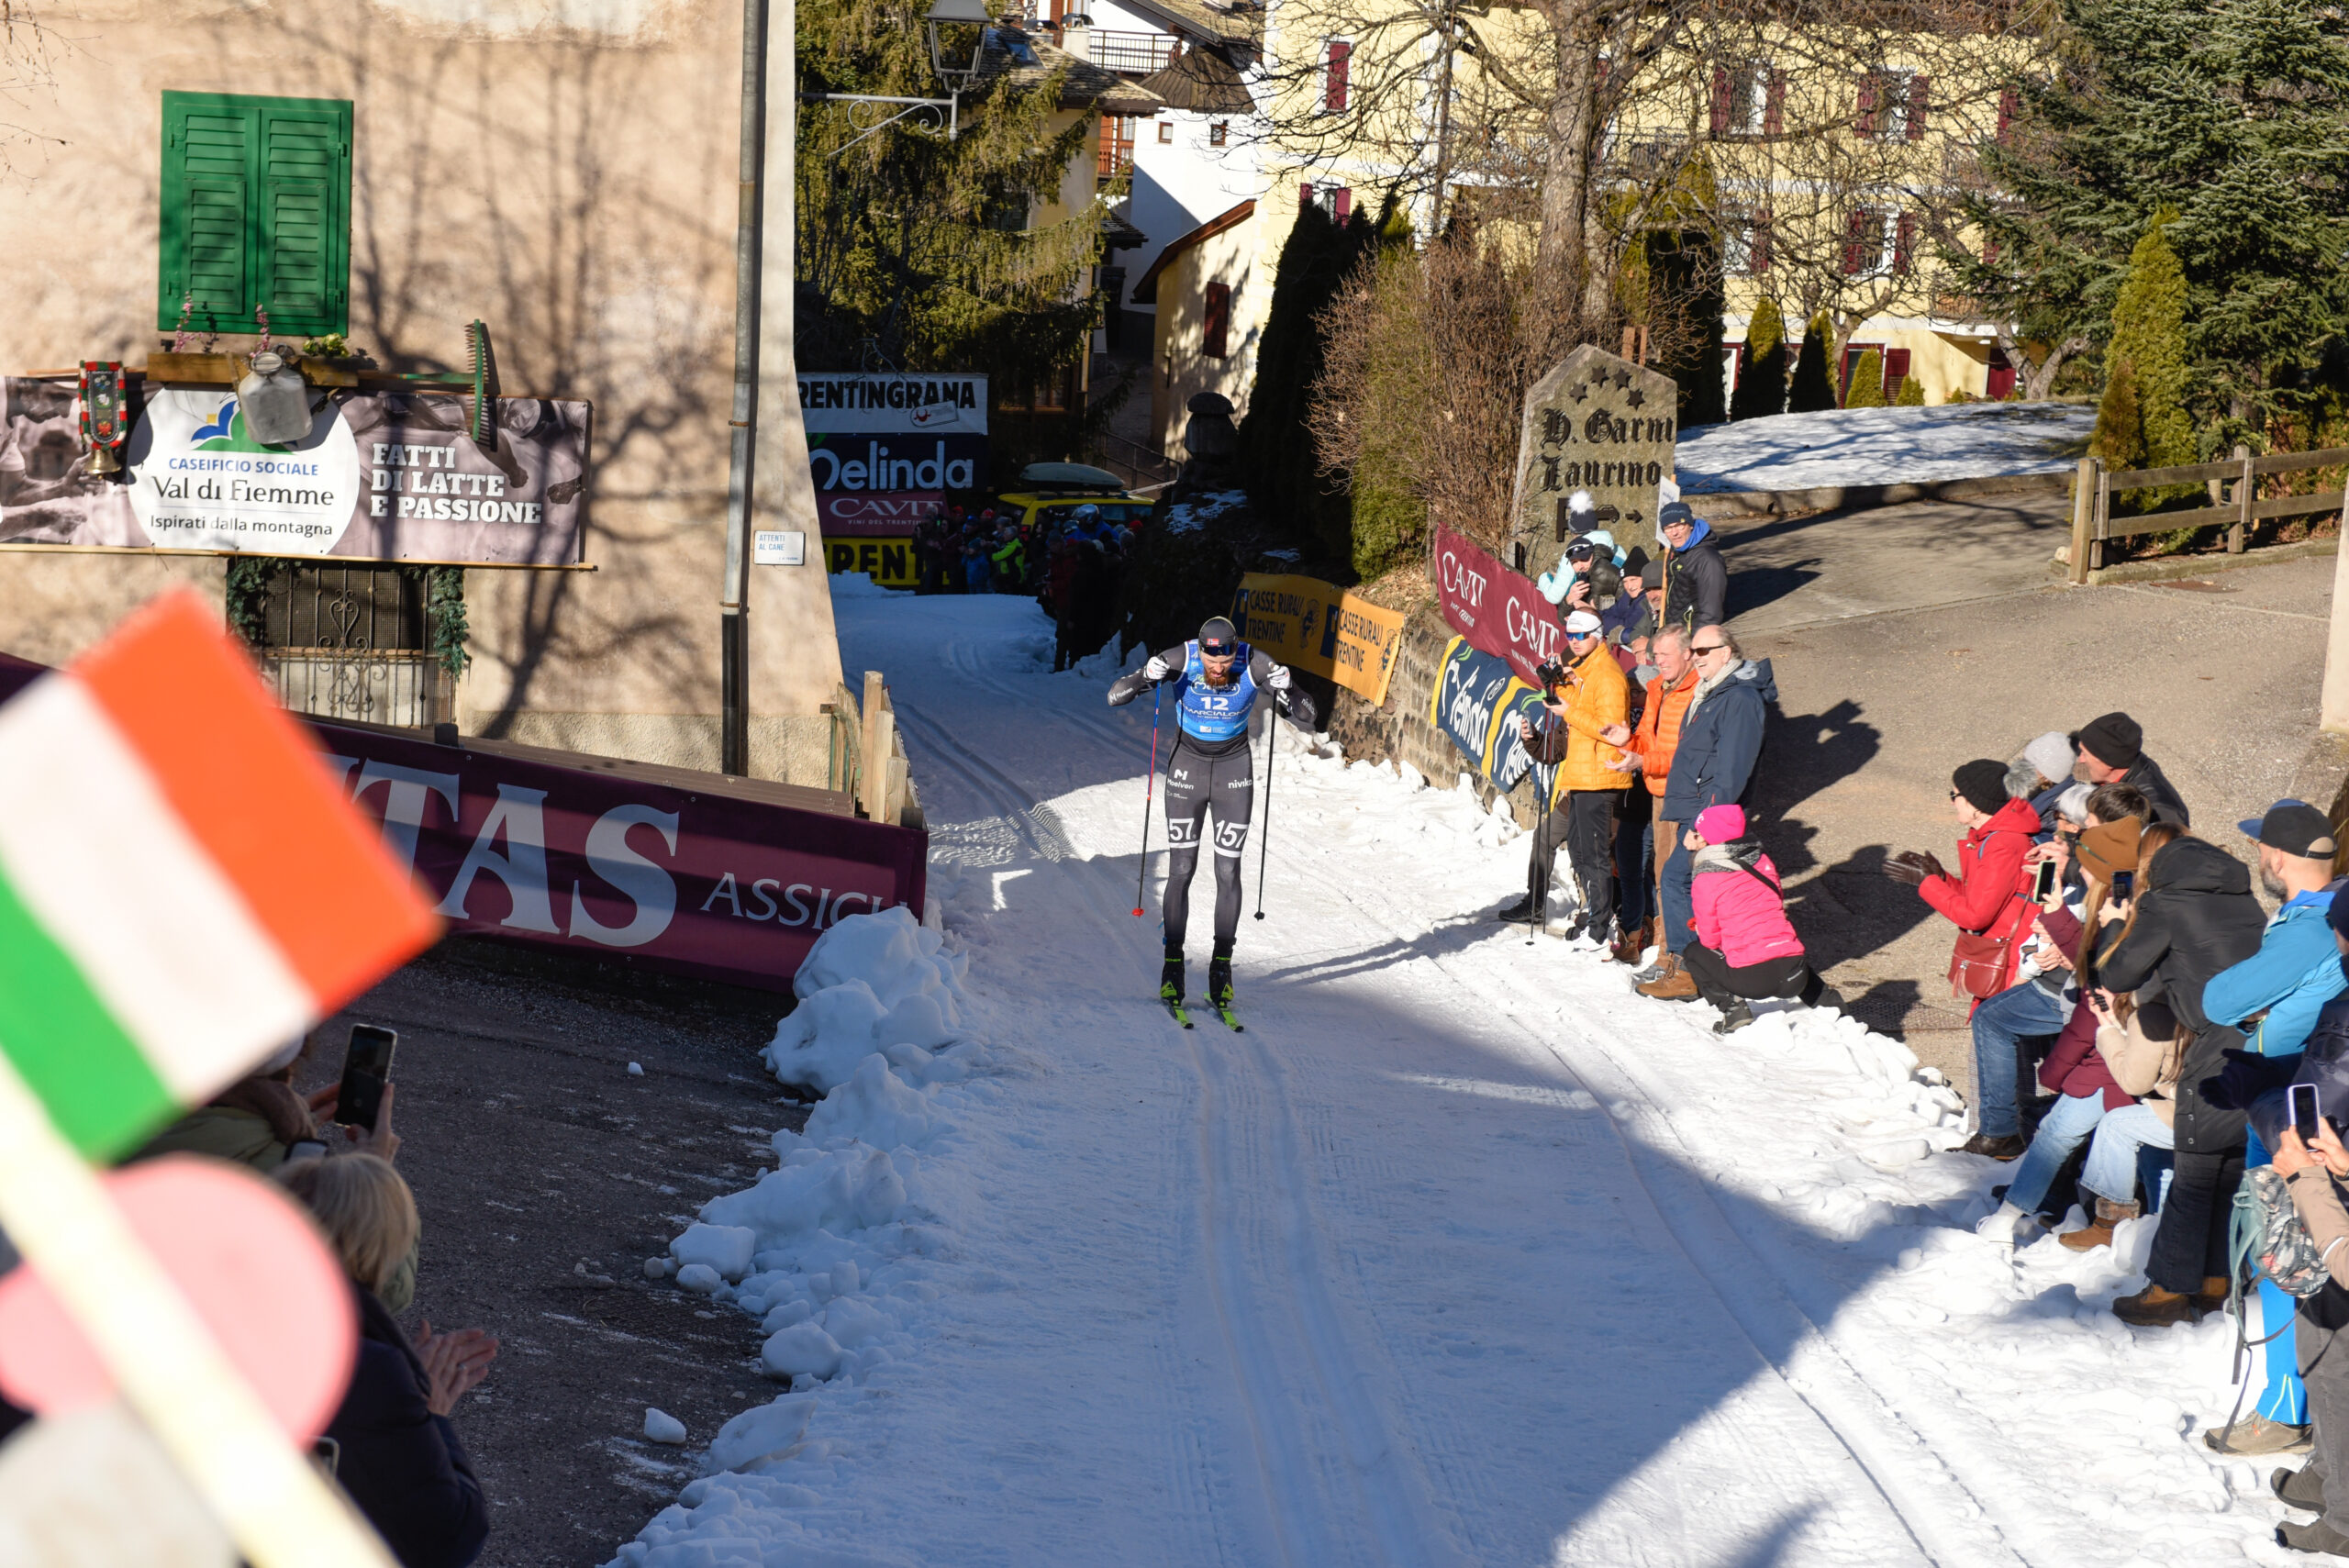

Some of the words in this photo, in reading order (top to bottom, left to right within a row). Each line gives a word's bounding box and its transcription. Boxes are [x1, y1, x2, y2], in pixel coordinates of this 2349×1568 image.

[169, 458, 251, 473] CASEIFICIO
[255, 461, 319, 476] SOCIALE
[372, 443, 456, 469] FATTI
[371, 469, 404, 492] DI
[411, 471, 505, 497] LATTE
[1541, 454, 1662, 492] Laurino
[151, 475, 190, 500] Val
[197, 477, 222, 500] di
[231, 479, 335, 506] Fiemme
[370, 495, 389, 517] E
[396, 496, 542, 524] PASSIONE
[829, 498, 943, 518] CAVIT
[150, 515, 206, 529] Ispirati
[210, 516, 248, 531] dalla
[252, 521, 333, 538] montagna
[759, 534, 785, 542] ATTENTI
[1249, 589, 1275, 613] CASSE
[1277, 593, 1306, 617] RURALI
[1248, 617, 1286, 644] TRENTINE
[1339, 608, 1360, 637] CASSE
[1359, 615, 1384, 647] RURALI
[1336, 639, 1365, 673] TRENTINE
[1200, 696, 1230, 711] 12
[1215, 819, 1249, 849] 157
[330, 754, 682, 949] TAS
